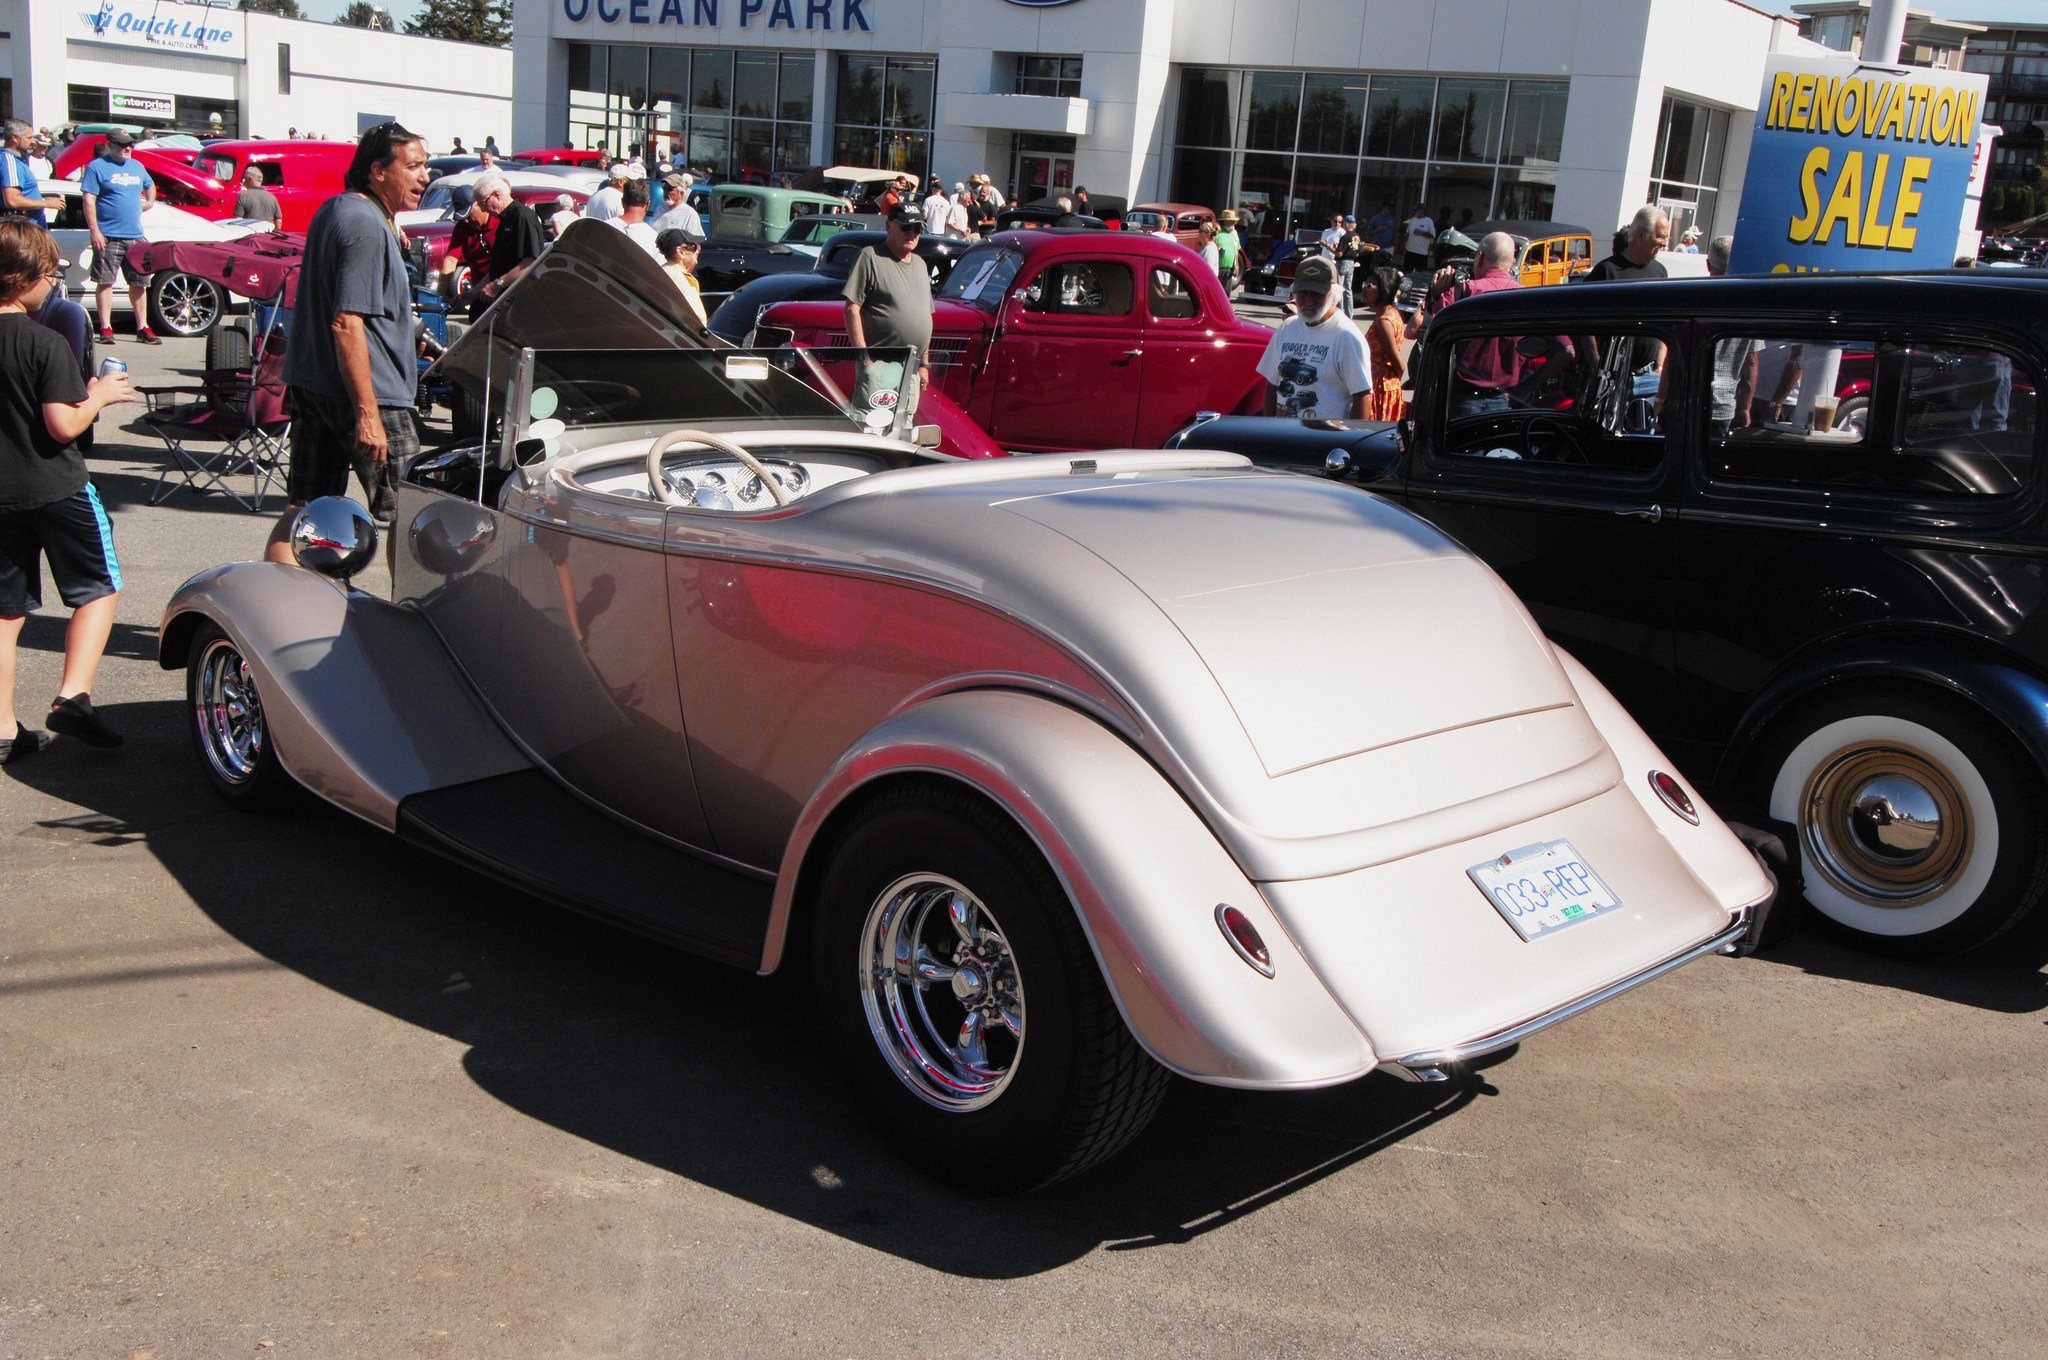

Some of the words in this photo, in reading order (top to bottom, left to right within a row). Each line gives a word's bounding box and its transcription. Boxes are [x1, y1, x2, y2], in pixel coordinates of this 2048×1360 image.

[116, 12, 178, 36] Quick
[181, 21, 233, 43] Lane
[564, 0, 718, 27] OCEAN
[739, 0, 871, 32] PARK
[113, 95, 171, 110] enterprise
[1766, 71, 1980, 147] RENOVATION
[1788, 146, 1932, 251] SALE
